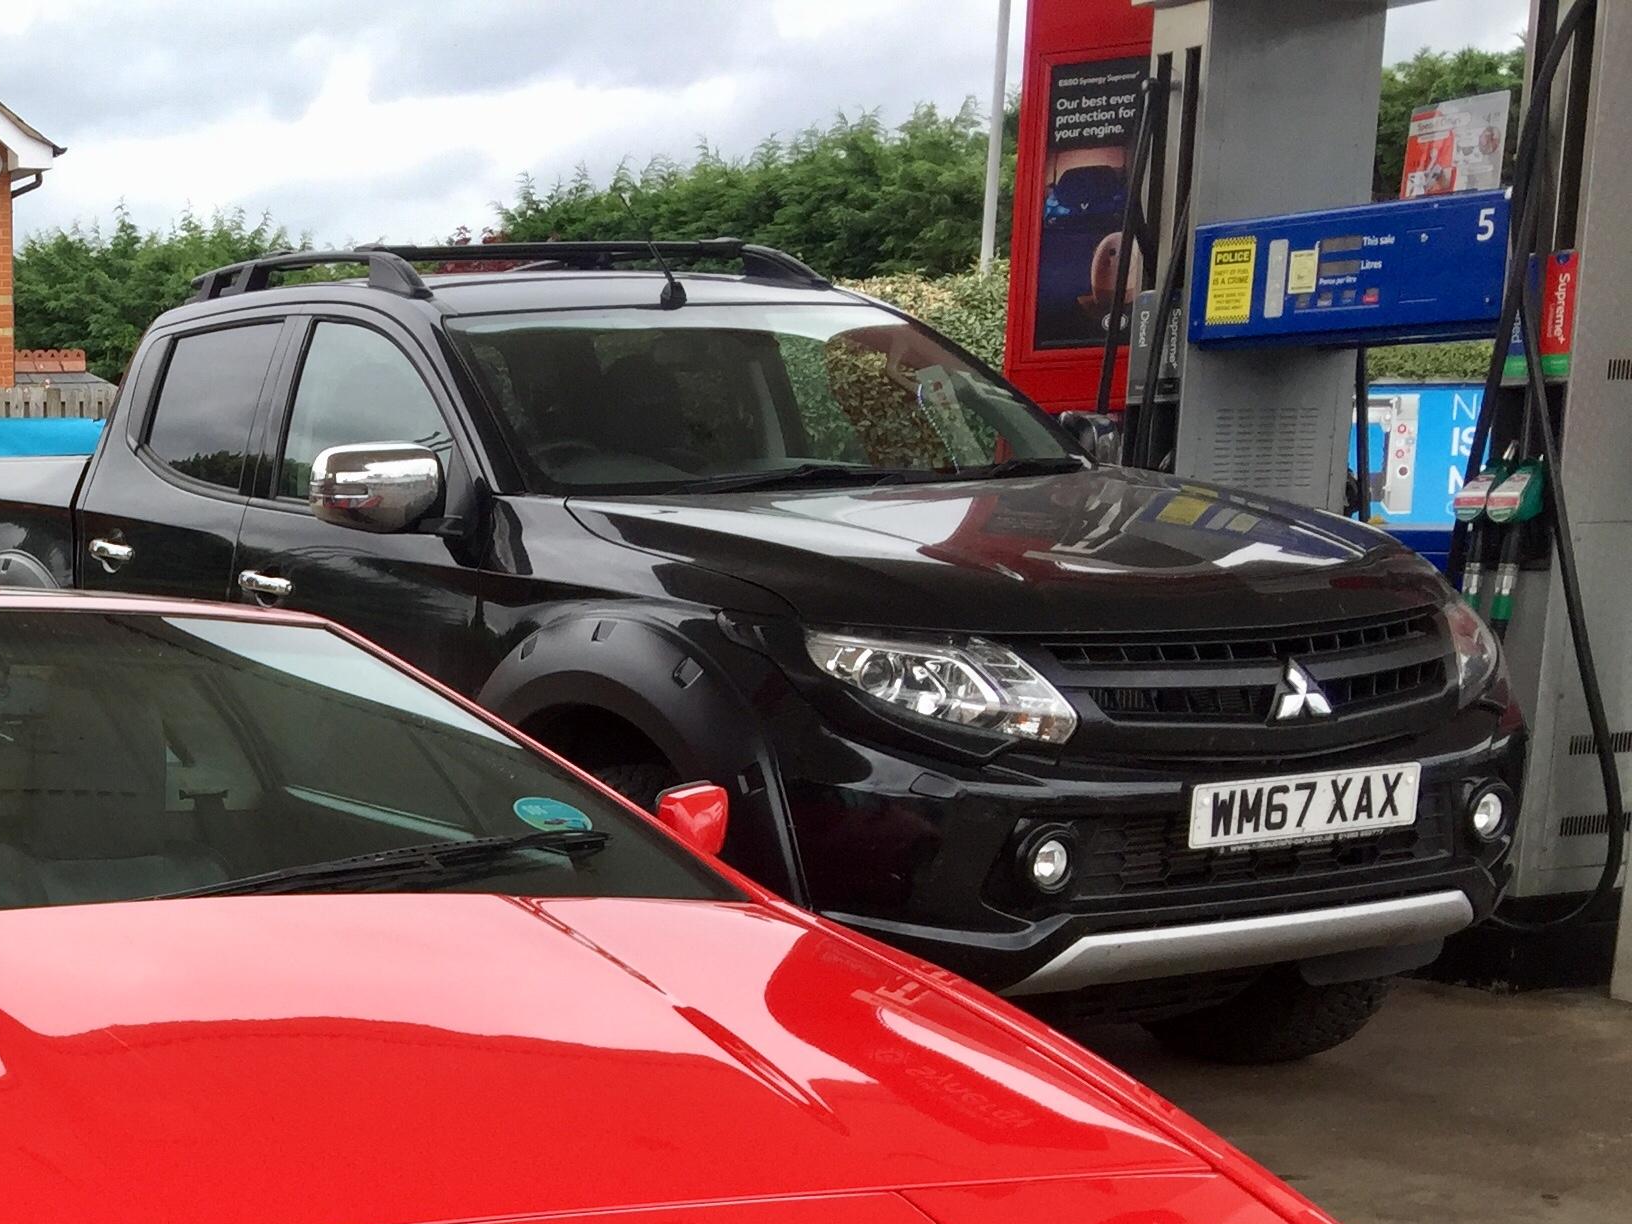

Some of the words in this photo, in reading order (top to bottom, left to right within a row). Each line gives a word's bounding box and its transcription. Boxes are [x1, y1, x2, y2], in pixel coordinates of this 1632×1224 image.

[1056, 98, 1079, 110] Our
[1081, 96, 1107, 107] best
[1109, 93, 1136, 104] ever
[1055, 109, 1116, 128] protection
[1118, 106, 1136, 118] for
[1055, 128, 1081, 142] your
[1082, 123, 1125, 138] engine.
[1476, 207, 1496, 241] 5
[1216, 250, 1250, 263] POLICE
[1360, 260, 1383, 270] Litres
[1554, 273, 1570, 345] Supreme+
[1138, 310, 1150, 348] Diesel
[1210, 781, 1318, 838] WM67
[1326, 772, 1404, 825] XAX
